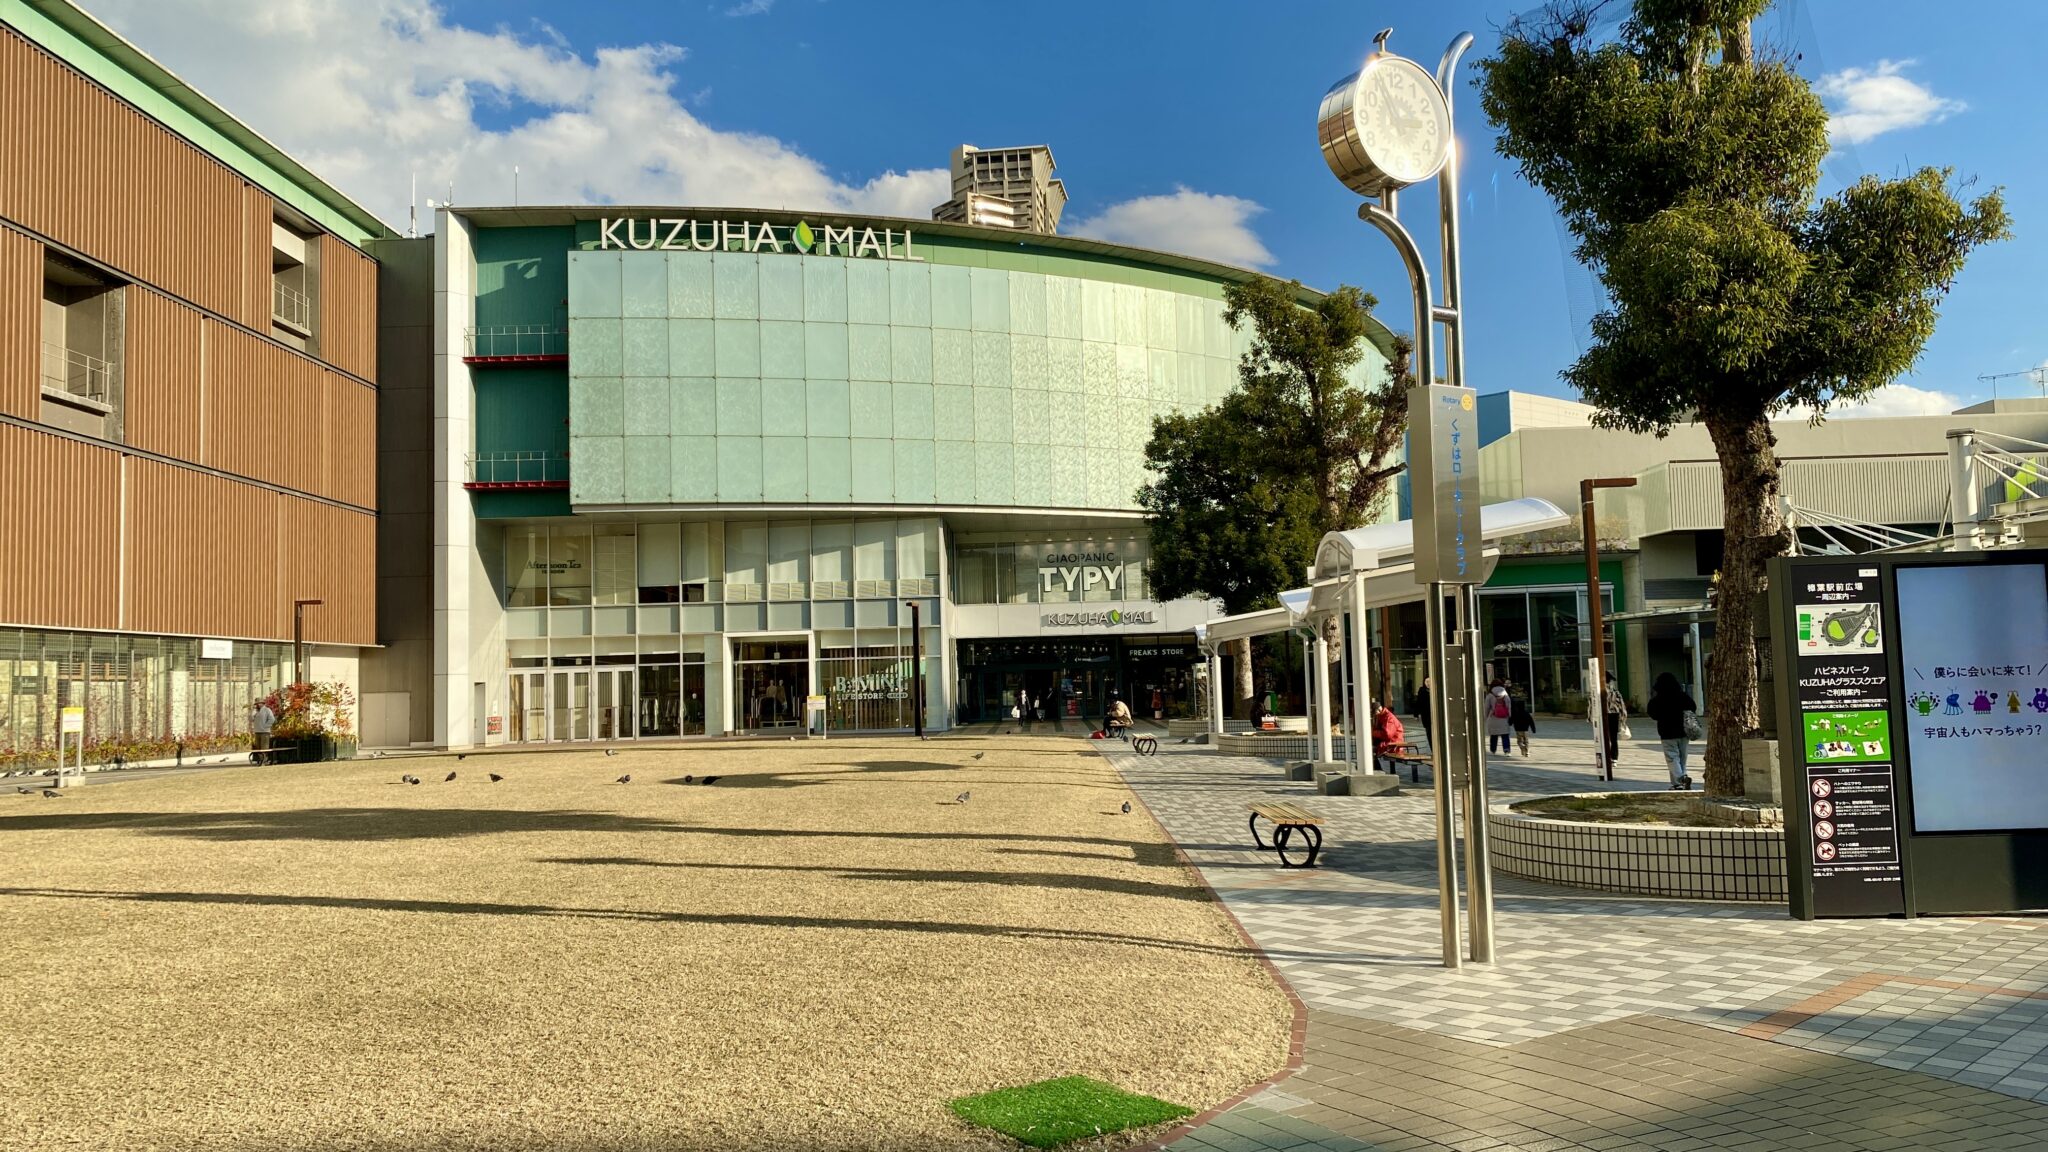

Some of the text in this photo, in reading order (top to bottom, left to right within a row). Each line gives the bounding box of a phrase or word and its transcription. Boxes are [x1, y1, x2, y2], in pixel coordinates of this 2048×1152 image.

[1386, 72, 1404, 91] 12
[1409, 84, 1417, 99] 1
[1361, 91, 1378, 108] 10
[1420, 98, 1430, 114] 2
[1359, 110, 1369, 126] 9
[1426, 120, 1437, 136] 3
[1366, 131, 1376, 147] 8
[1422, 140, 1433, 155] 4
[1412, 152, 1422, 169] 5
[601, 217, 925, 262] KUZUHA MALL
[1442, 395, 1461, 406] Rotary
[567, 559, 582, 569] Tea
[1046, 552, 1115, 564] CIAOPANIC
[1039, 565, 1123, 592] TYPY
[1048, 611, 1158, 625] KUZUHA MALL
[1161, 648, 1184, 656] STORE
[1799, 676, 1886, 687] KUZUHAグラススクエア
[857, 692, 884, 700] STORE
